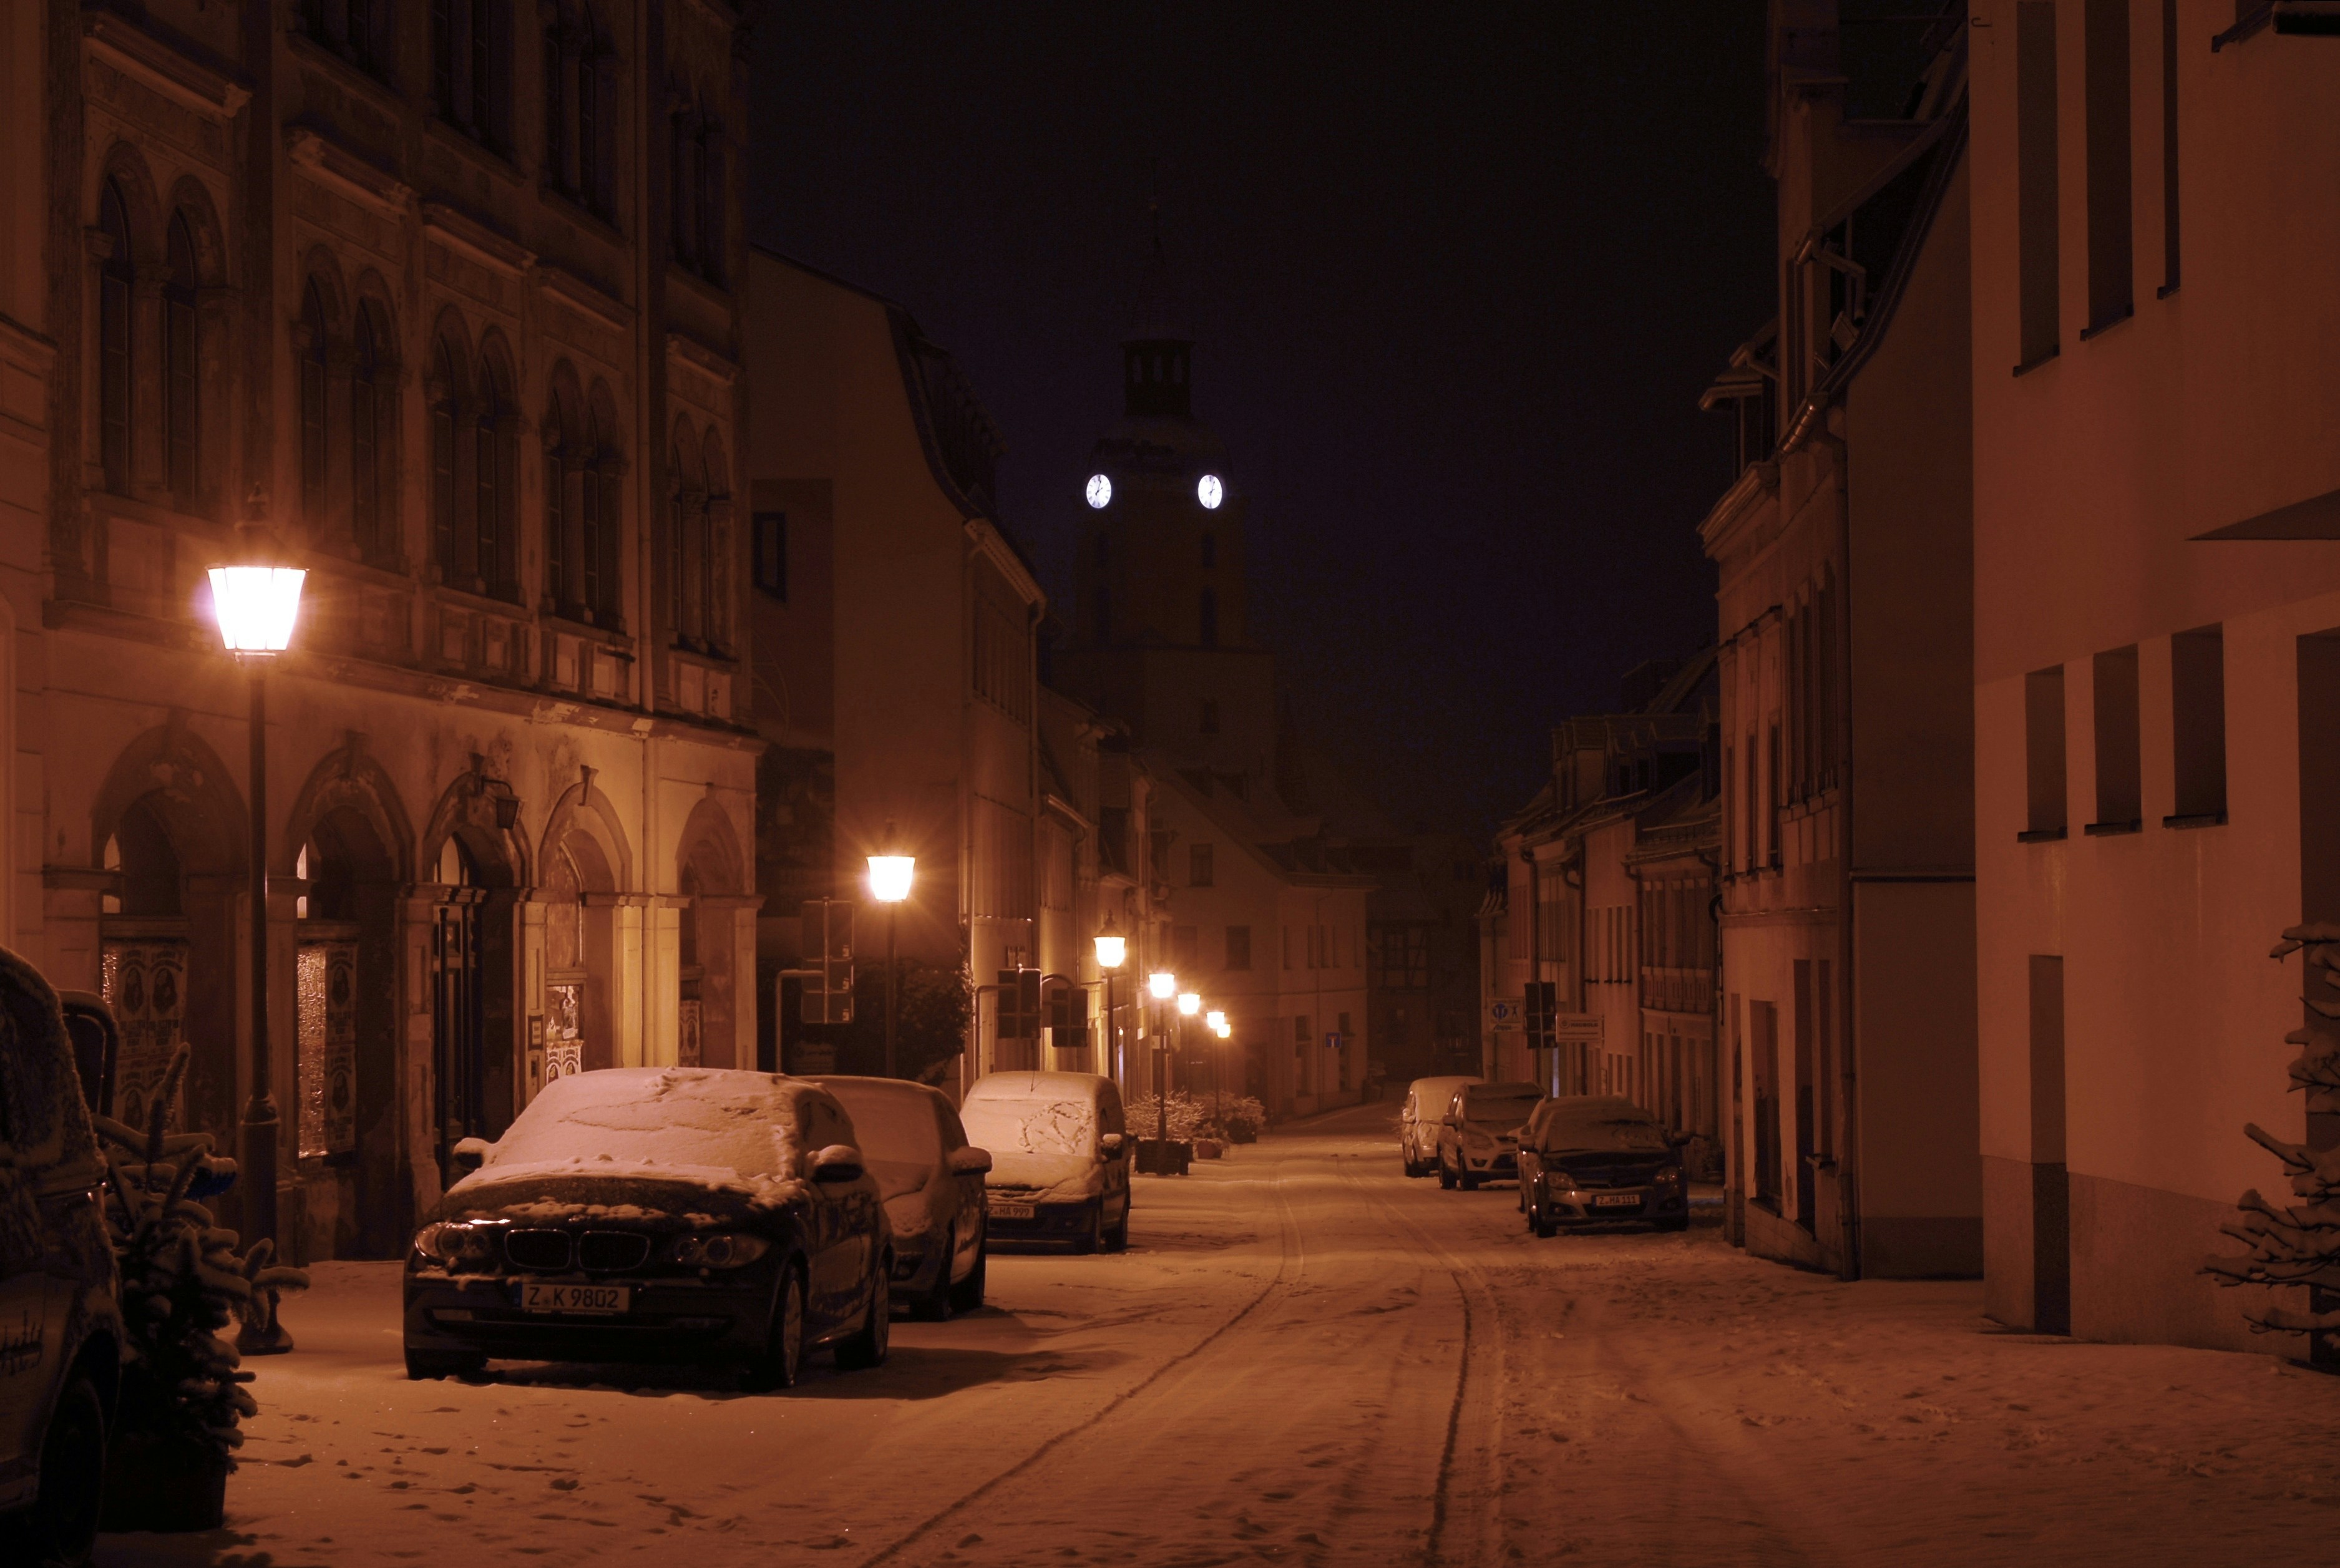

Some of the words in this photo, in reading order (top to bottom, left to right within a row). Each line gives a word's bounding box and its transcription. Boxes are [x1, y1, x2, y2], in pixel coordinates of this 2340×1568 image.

[1599, 1197, 1604, 1205] Z
[1622, 1195, 1636, 1204] 111
[1000, 1207, 1010, 1215] HA
[1013, 1207, 1030, 1216] 999
[529, 1287, 540, 1305] Z
[553, 1288, 565, 1307] K
[571, 1288, 618, 1308] 9802
